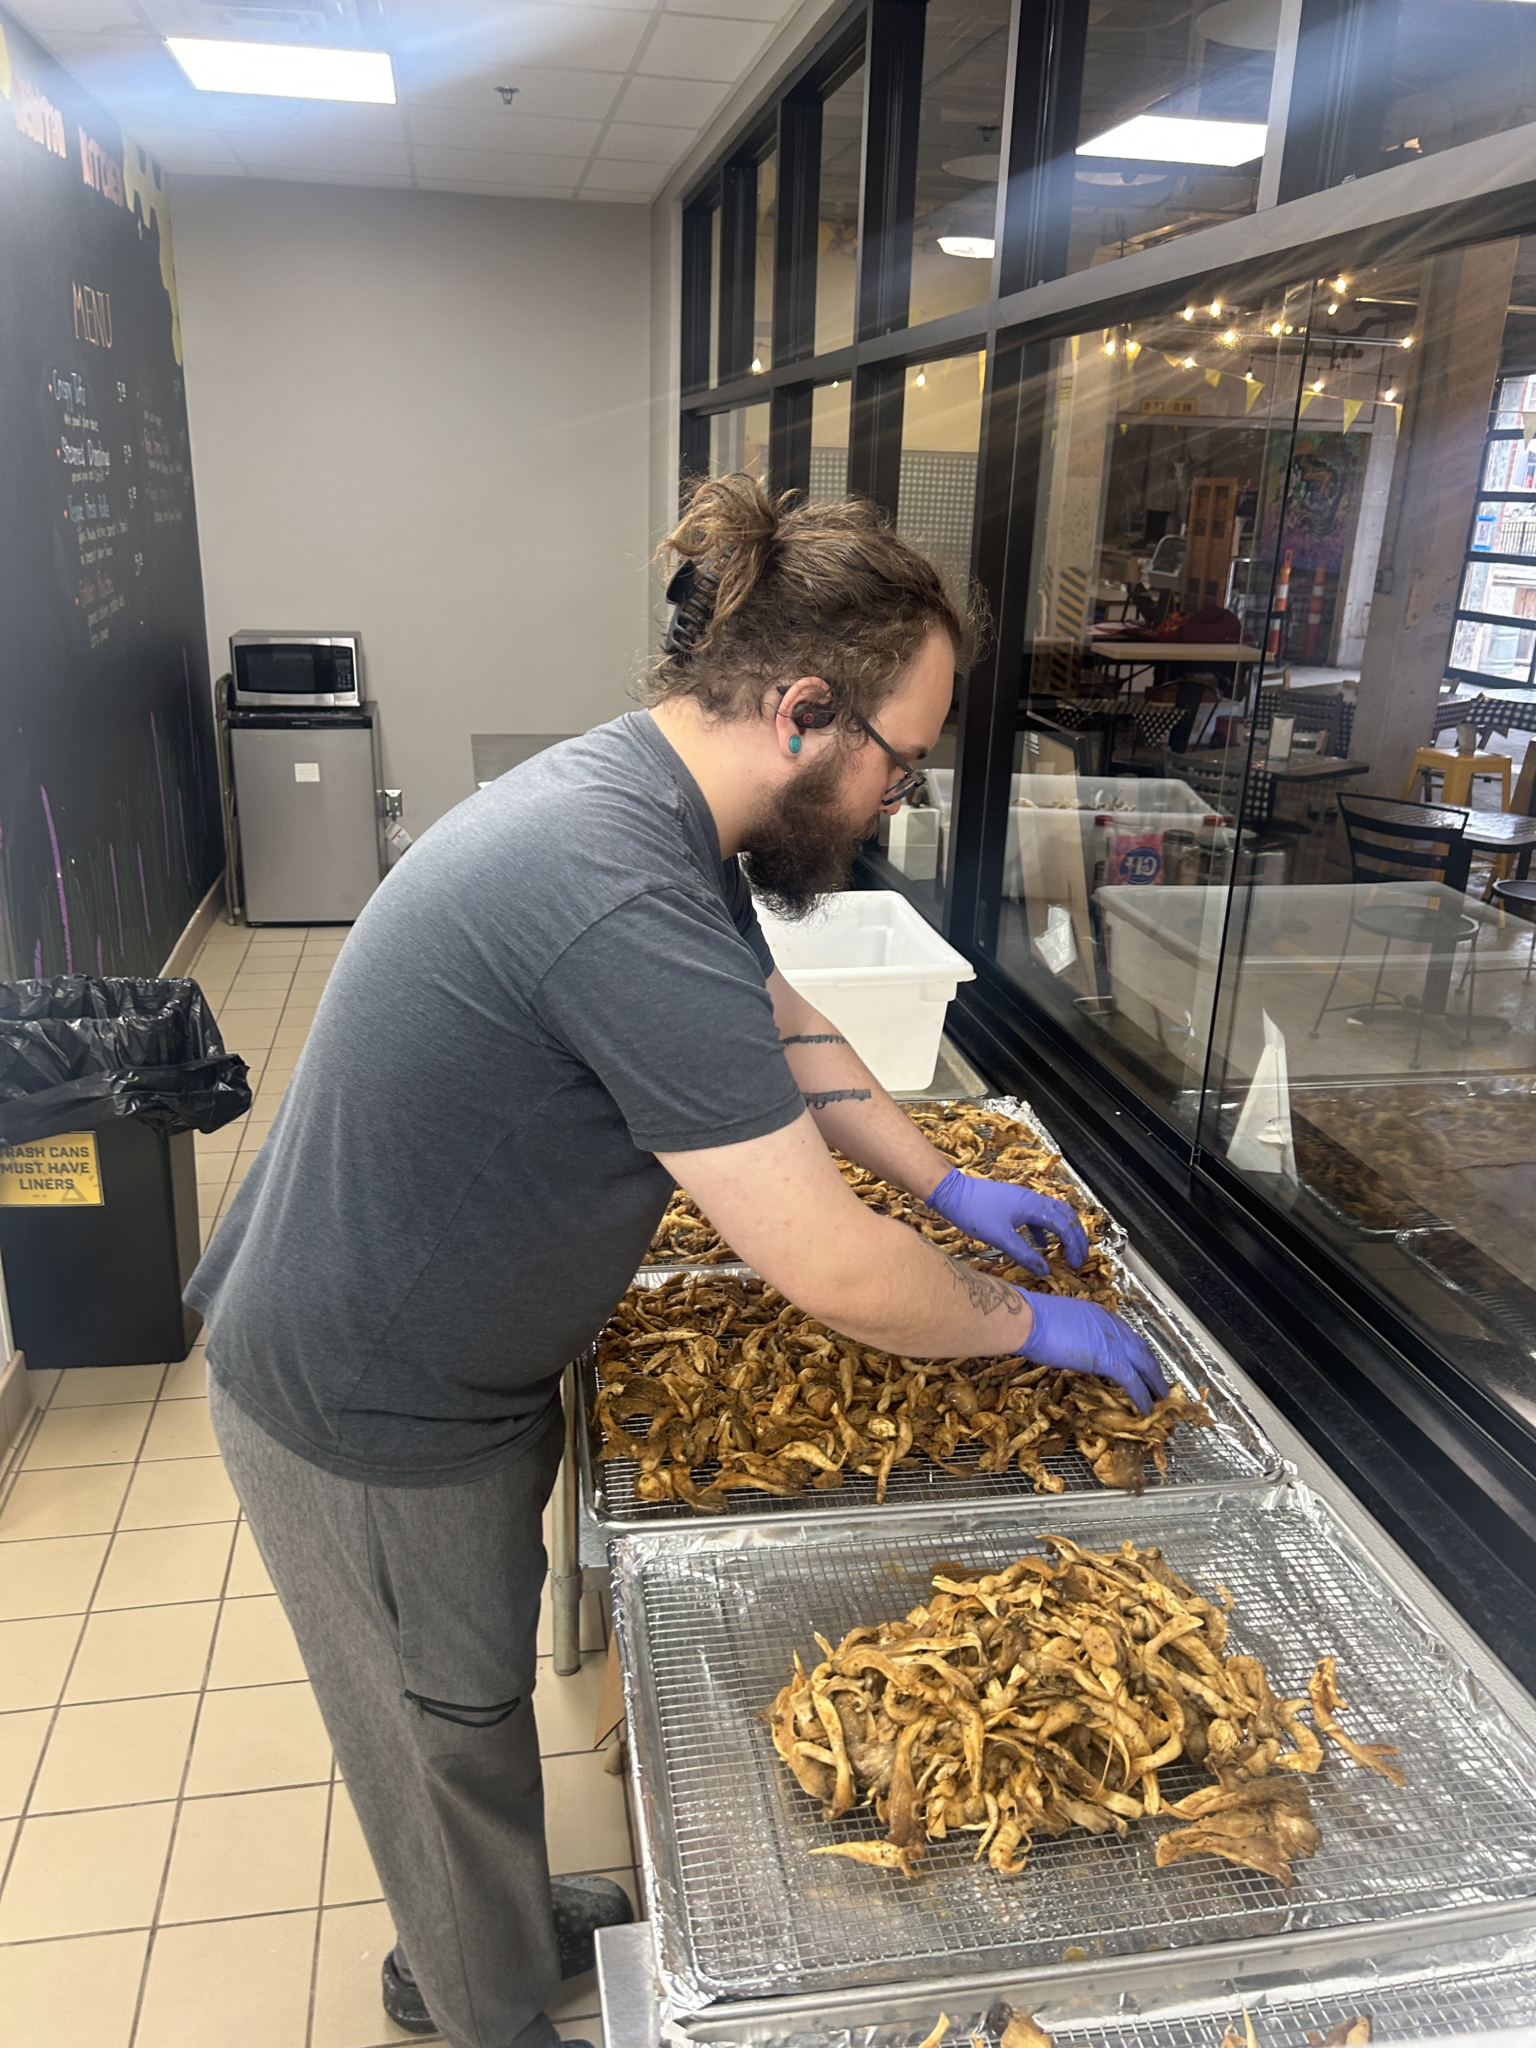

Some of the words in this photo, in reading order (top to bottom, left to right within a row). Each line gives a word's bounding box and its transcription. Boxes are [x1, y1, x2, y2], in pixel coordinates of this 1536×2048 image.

[72, 280, 112, 349] MENU
[49, 1146, 89, 1158] CANS
[0, 1162, 43, 1174] MUST
[48, 1162, 90, 1174] HAVE
[19, 1178, 75, 1190] LINERS
